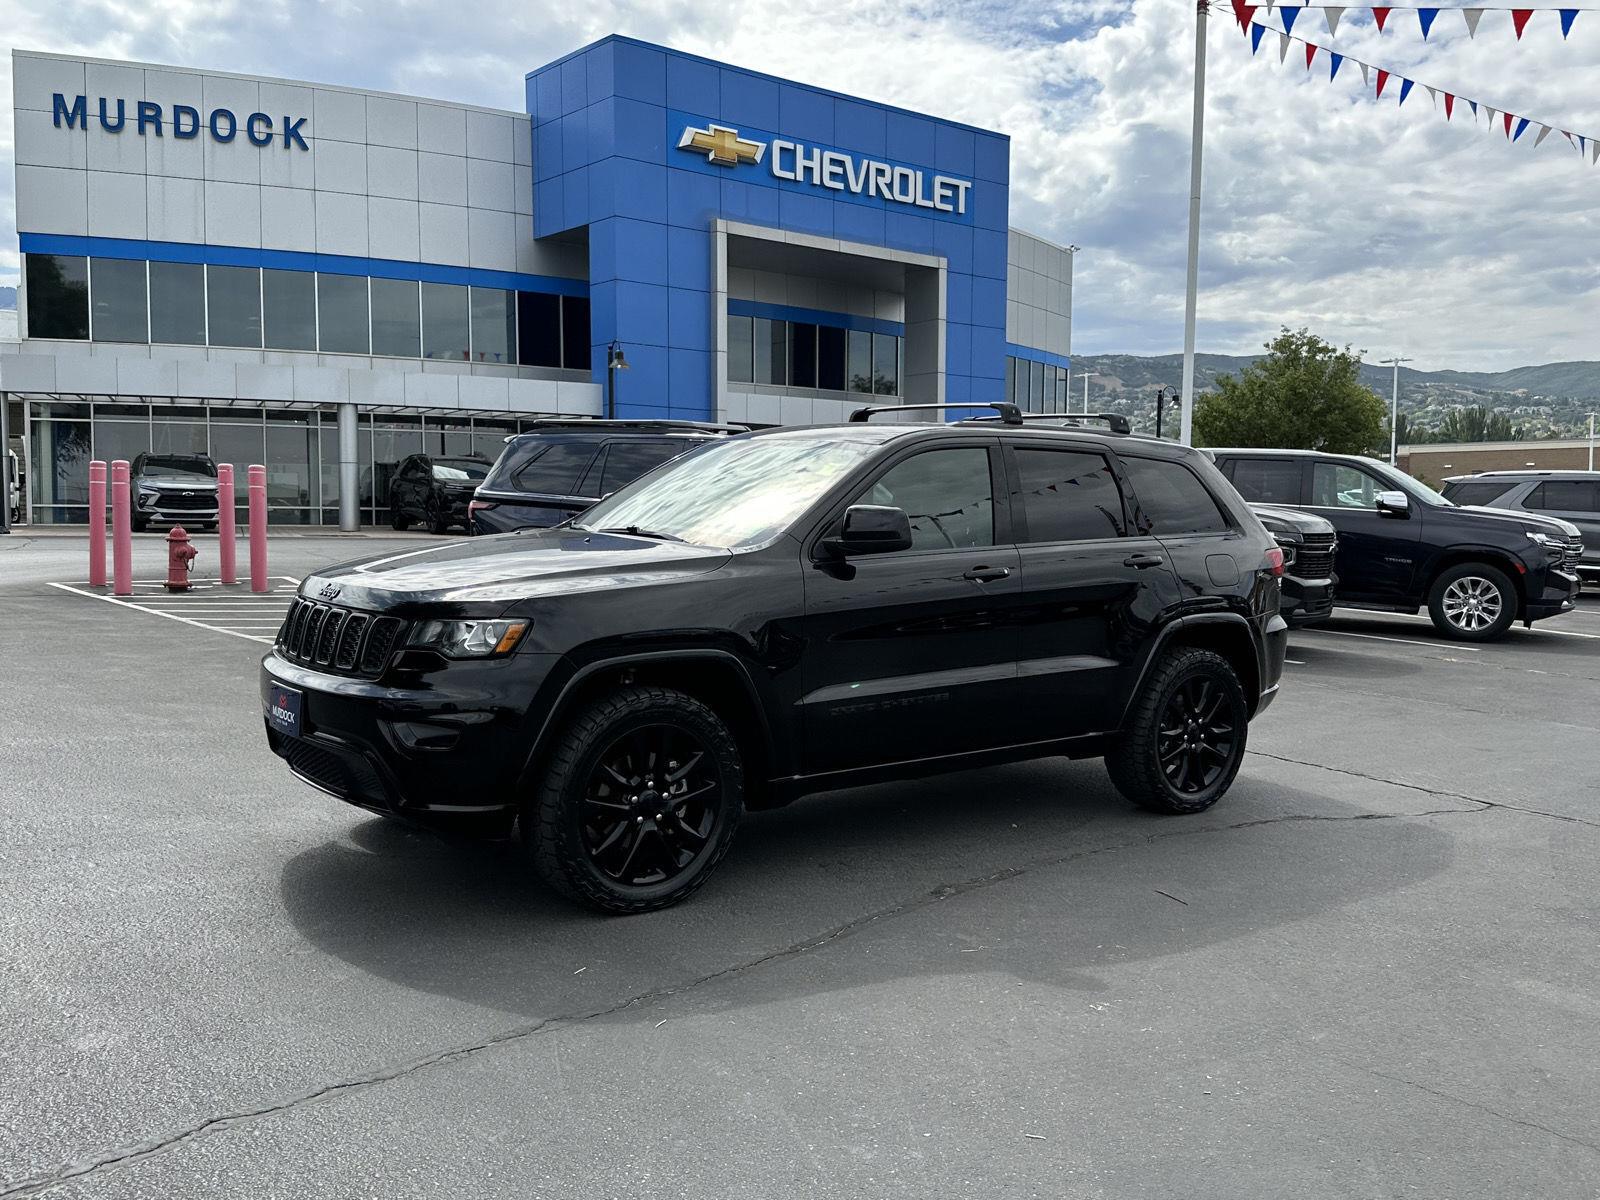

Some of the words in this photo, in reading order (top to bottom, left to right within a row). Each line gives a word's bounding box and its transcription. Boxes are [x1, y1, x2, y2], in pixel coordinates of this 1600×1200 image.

[52, 93, 309, 151] MURDOCK
[771, 139, 971, 214] CHEVROLET
[272, 705, 295, 724] MURDOCK
